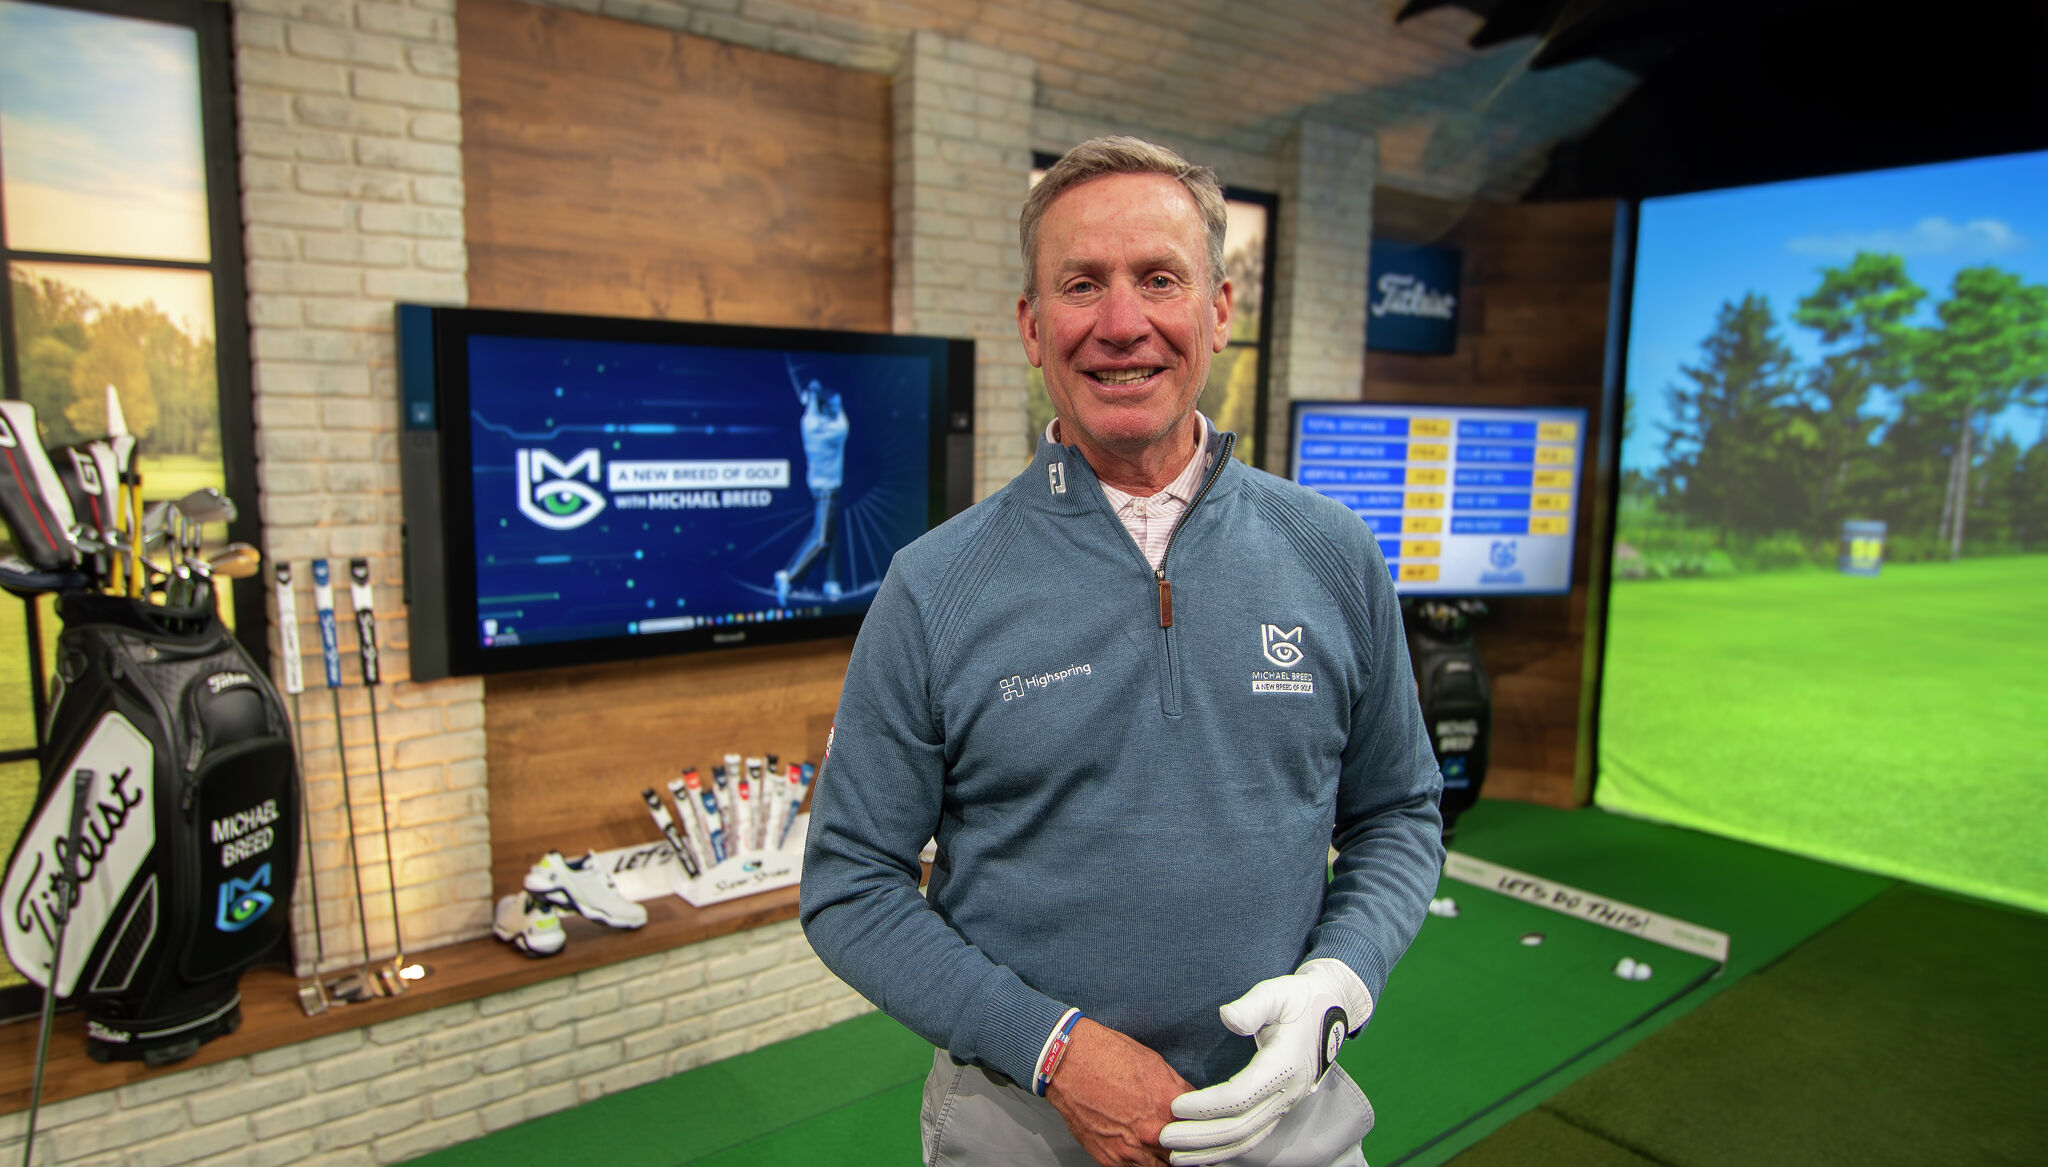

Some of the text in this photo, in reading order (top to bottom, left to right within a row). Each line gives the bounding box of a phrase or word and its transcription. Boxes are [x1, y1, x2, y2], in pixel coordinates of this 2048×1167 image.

[618, 467, 780, 482] A NEW BREED OF GOLF
[614, 490, 772, 510] WITH MICHAEL BREED
[1025, 663, 1092, 689] Highspring
[1252, 671, 1313, 681] MICHAEL BREED
[211, 799, 280, 844] MICHAEL
[221, 825, 274, 868] BREED
[1552, 889, 1581, 909] DO
